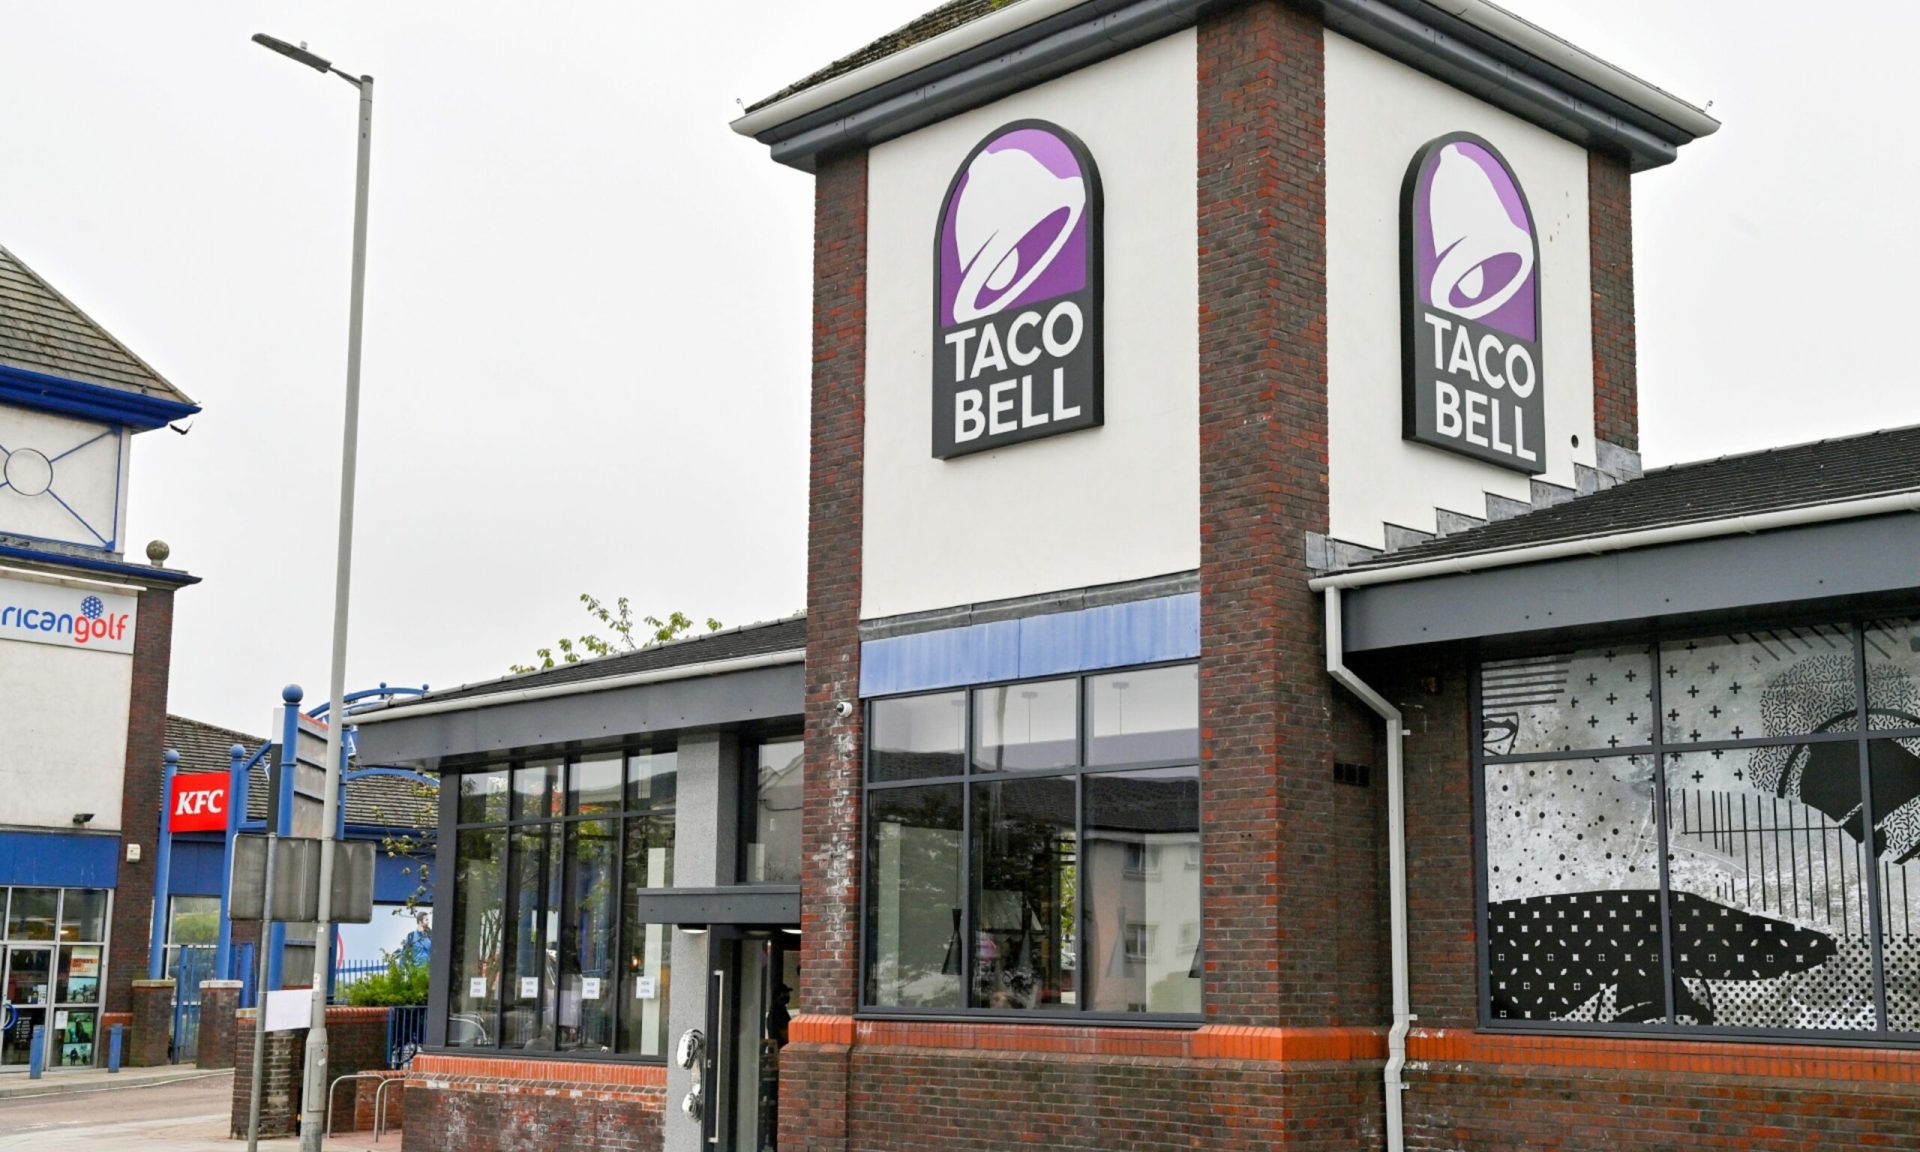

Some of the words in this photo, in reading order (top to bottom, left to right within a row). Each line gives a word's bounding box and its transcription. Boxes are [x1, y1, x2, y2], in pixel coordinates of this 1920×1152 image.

[944, 301, 1084, 382] TACO
[1424, 312, 1536, 398] TACO
[954, 367, 1081, 443] BELL
[1435, 380, 1537, 462] BELL
[175, 789, 224, 816] KFC
